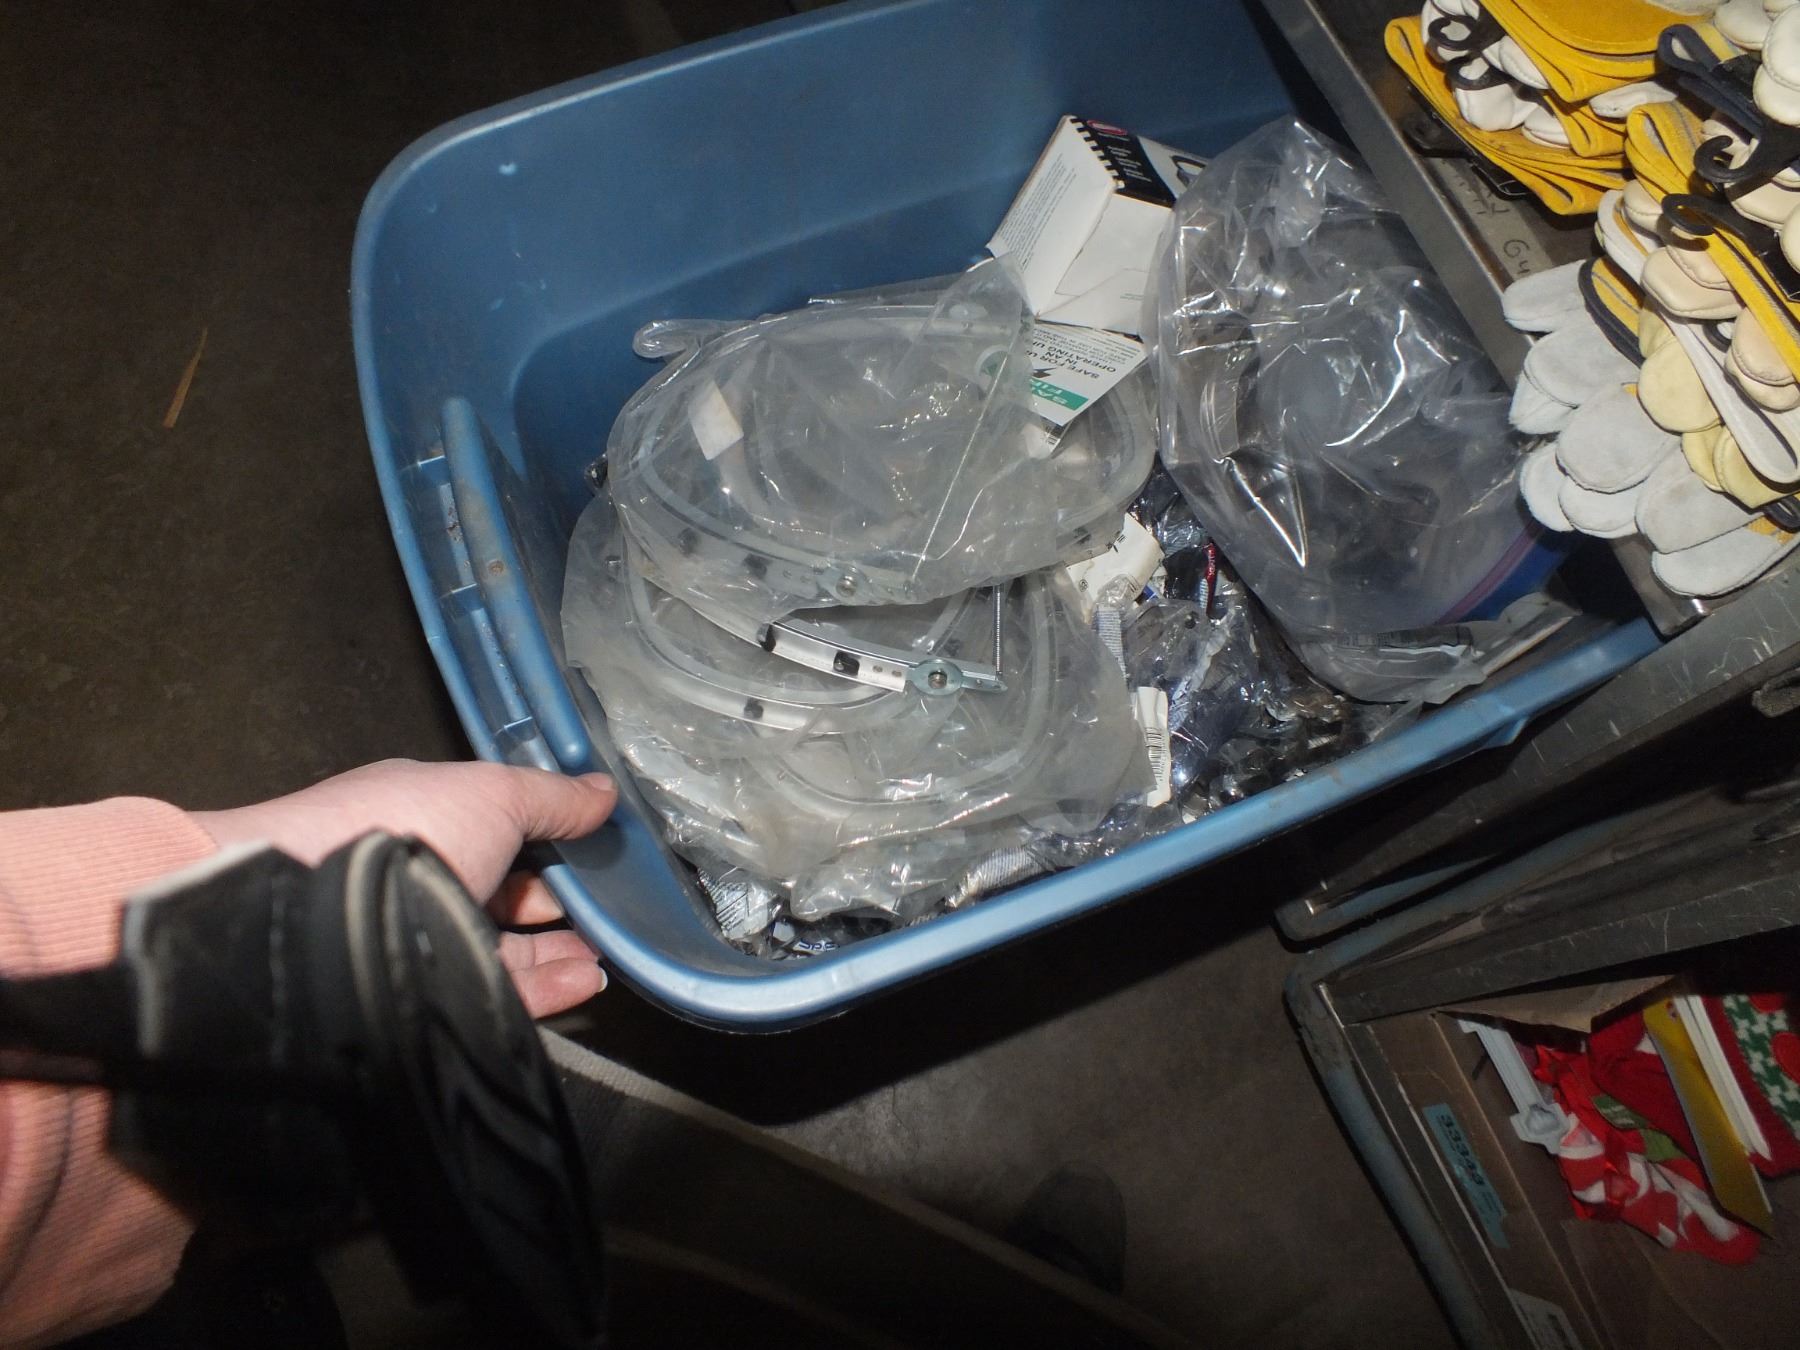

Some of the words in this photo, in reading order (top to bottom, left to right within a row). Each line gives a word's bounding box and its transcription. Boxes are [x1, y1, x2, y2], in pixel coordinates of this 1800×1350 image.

[1039, 355, 1066, 367] FOR
[1045, 351, 1062, 360] AN
[1047, 346, 1117, 373] OPERATING
[1065, 358, 1077, 366] IN
[1067, 366, 1100, 379] SAFE
